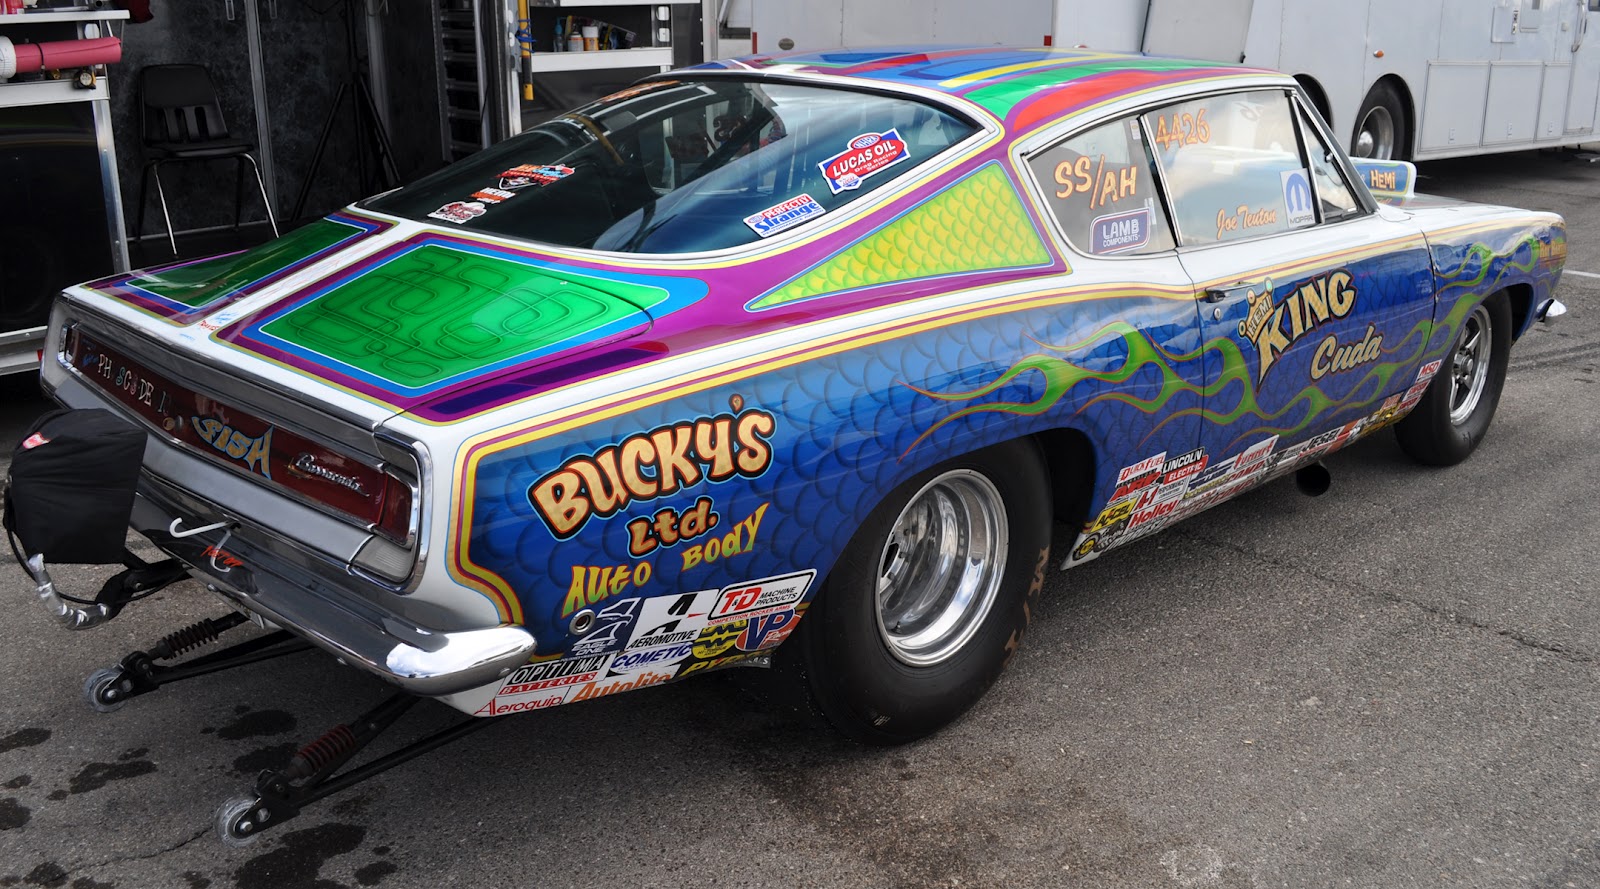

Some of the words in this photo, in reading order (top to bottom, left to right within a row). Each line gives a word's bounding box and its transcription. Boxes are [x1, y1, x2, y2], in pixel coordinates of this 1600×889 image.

[1155, 108, 1212, 150] 4426
[832, 149, 873, 177] LUCAS
[874, 140, 896, 156] OIL
[854, 162, 872, 173] Drag
[873, 150, 897, 164] Racing
[866, 158, 889, 171] Series
[1054, 154, 1137, 210] SS/AH
[754, 202, 820, 232] Strange
[763, 194, 812, 217] PERFECTLY
[1102, 218, 1140, 240] LAMB
[1216, 207, 1239, 240] Joe
[1289, 214, 1314, 224] MOPAR
[1247, 296, 1272, 337] HEMI
[1256, 269, 1356, 389] KING
[1310, 323, 1384, 382] Cuda
[191, 416, 275, 481] FISH
[1162, 449, 1204, 474] LINCOLN
[1168, 461, 1203, 481] ELECTRIC
[629, 499, 718, 555] Ltd.
[1128, 499, 1180, 529] Holley
[754, 592, 798, 607] PRODUCTS
[759, 586, 797, 600] MACHINE
[707, 611, 749, 626] COMPETITION
[748, 607, 775, 617] ROCKER
[774, 604, 792, 612] ARMS
[625, 629, 698, 650] AEROMOTIVE
[744, 608, 796, 651] VP
[571, 637, 618, 652] EAGLE
[575, 646, 606, 656] ONE
[610, 642, 693, 670] COMETIC
[508, 654, 606, 686] OPTIMA
[499, 672, 599, 695] BATTERIES
[569, 671, 672, 704] Autolite
[473, 693, 564, 717] Aeroquip
